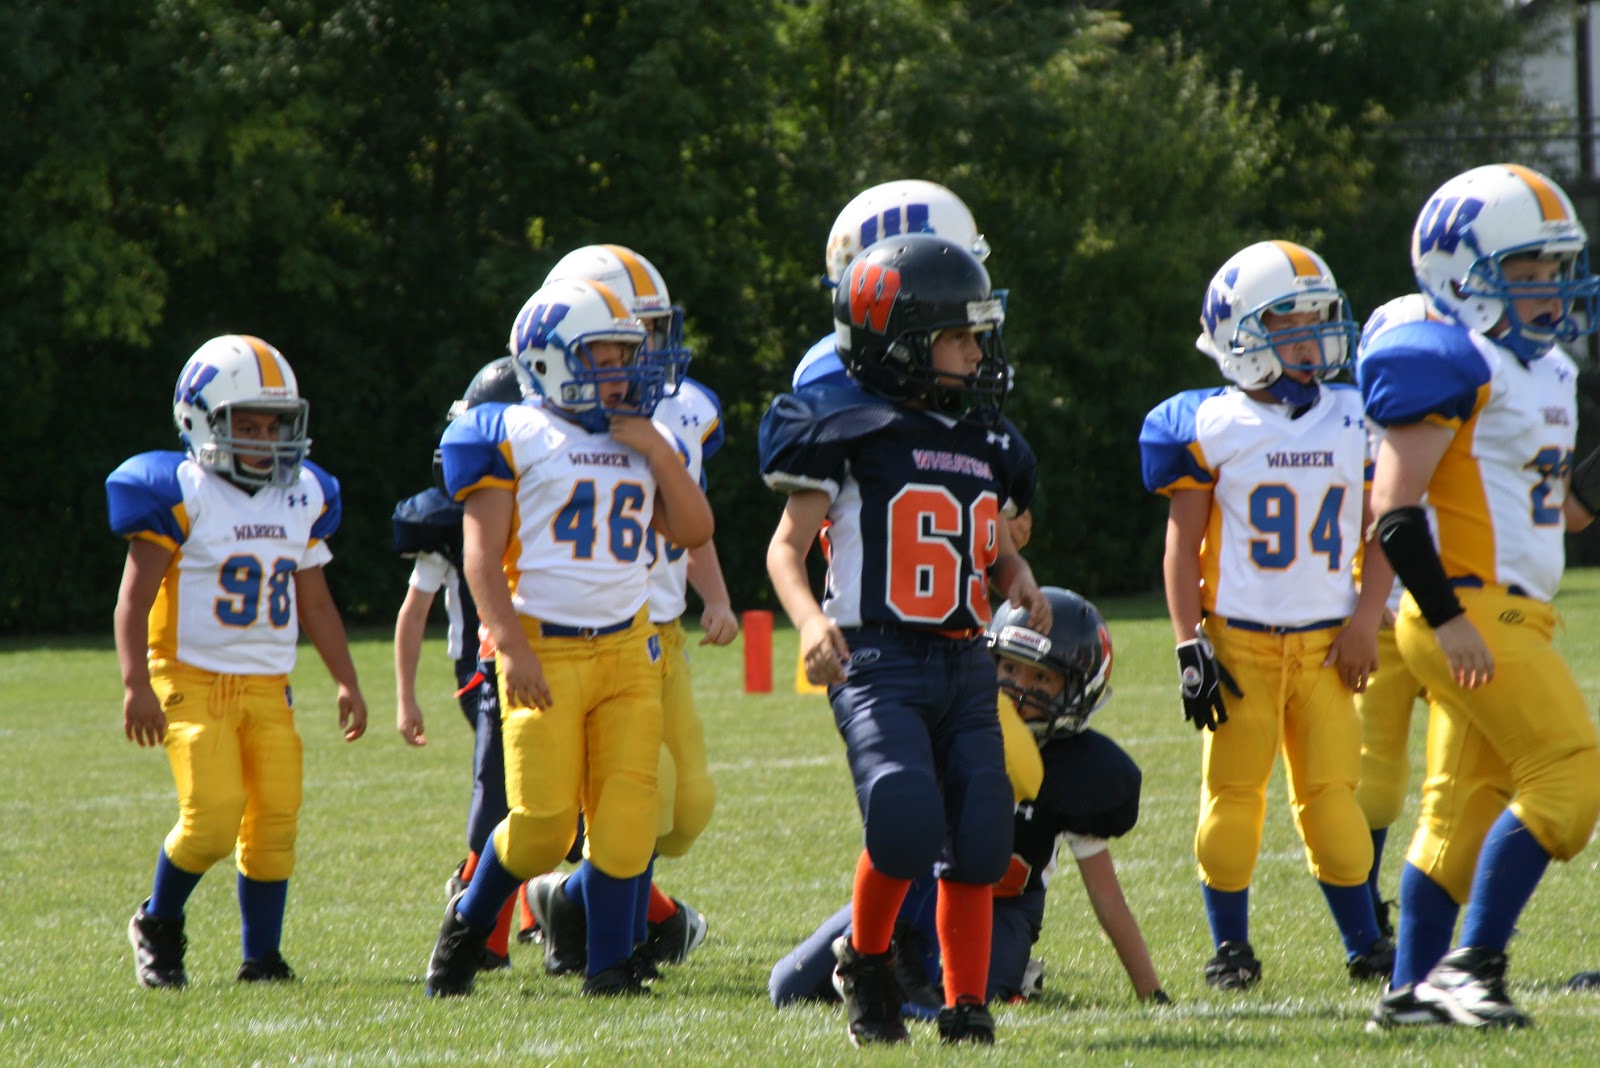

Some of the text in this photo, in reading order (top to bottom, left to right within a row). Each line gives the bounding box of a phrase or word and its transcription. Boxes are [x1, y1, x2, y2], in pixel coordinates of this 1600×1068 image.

[850, 260, 902, 335] W
[568, 452, 631, 468] WARREN
[1265, 451, 1334, 468] WARREN
[233, 525, 288, 541] WARREN
[552, 478, 646, 563] 46
[886, 482, 999, 625] 69
[1248, 483, 1347, 571] 94
[214, 553, 299, 629] 98
